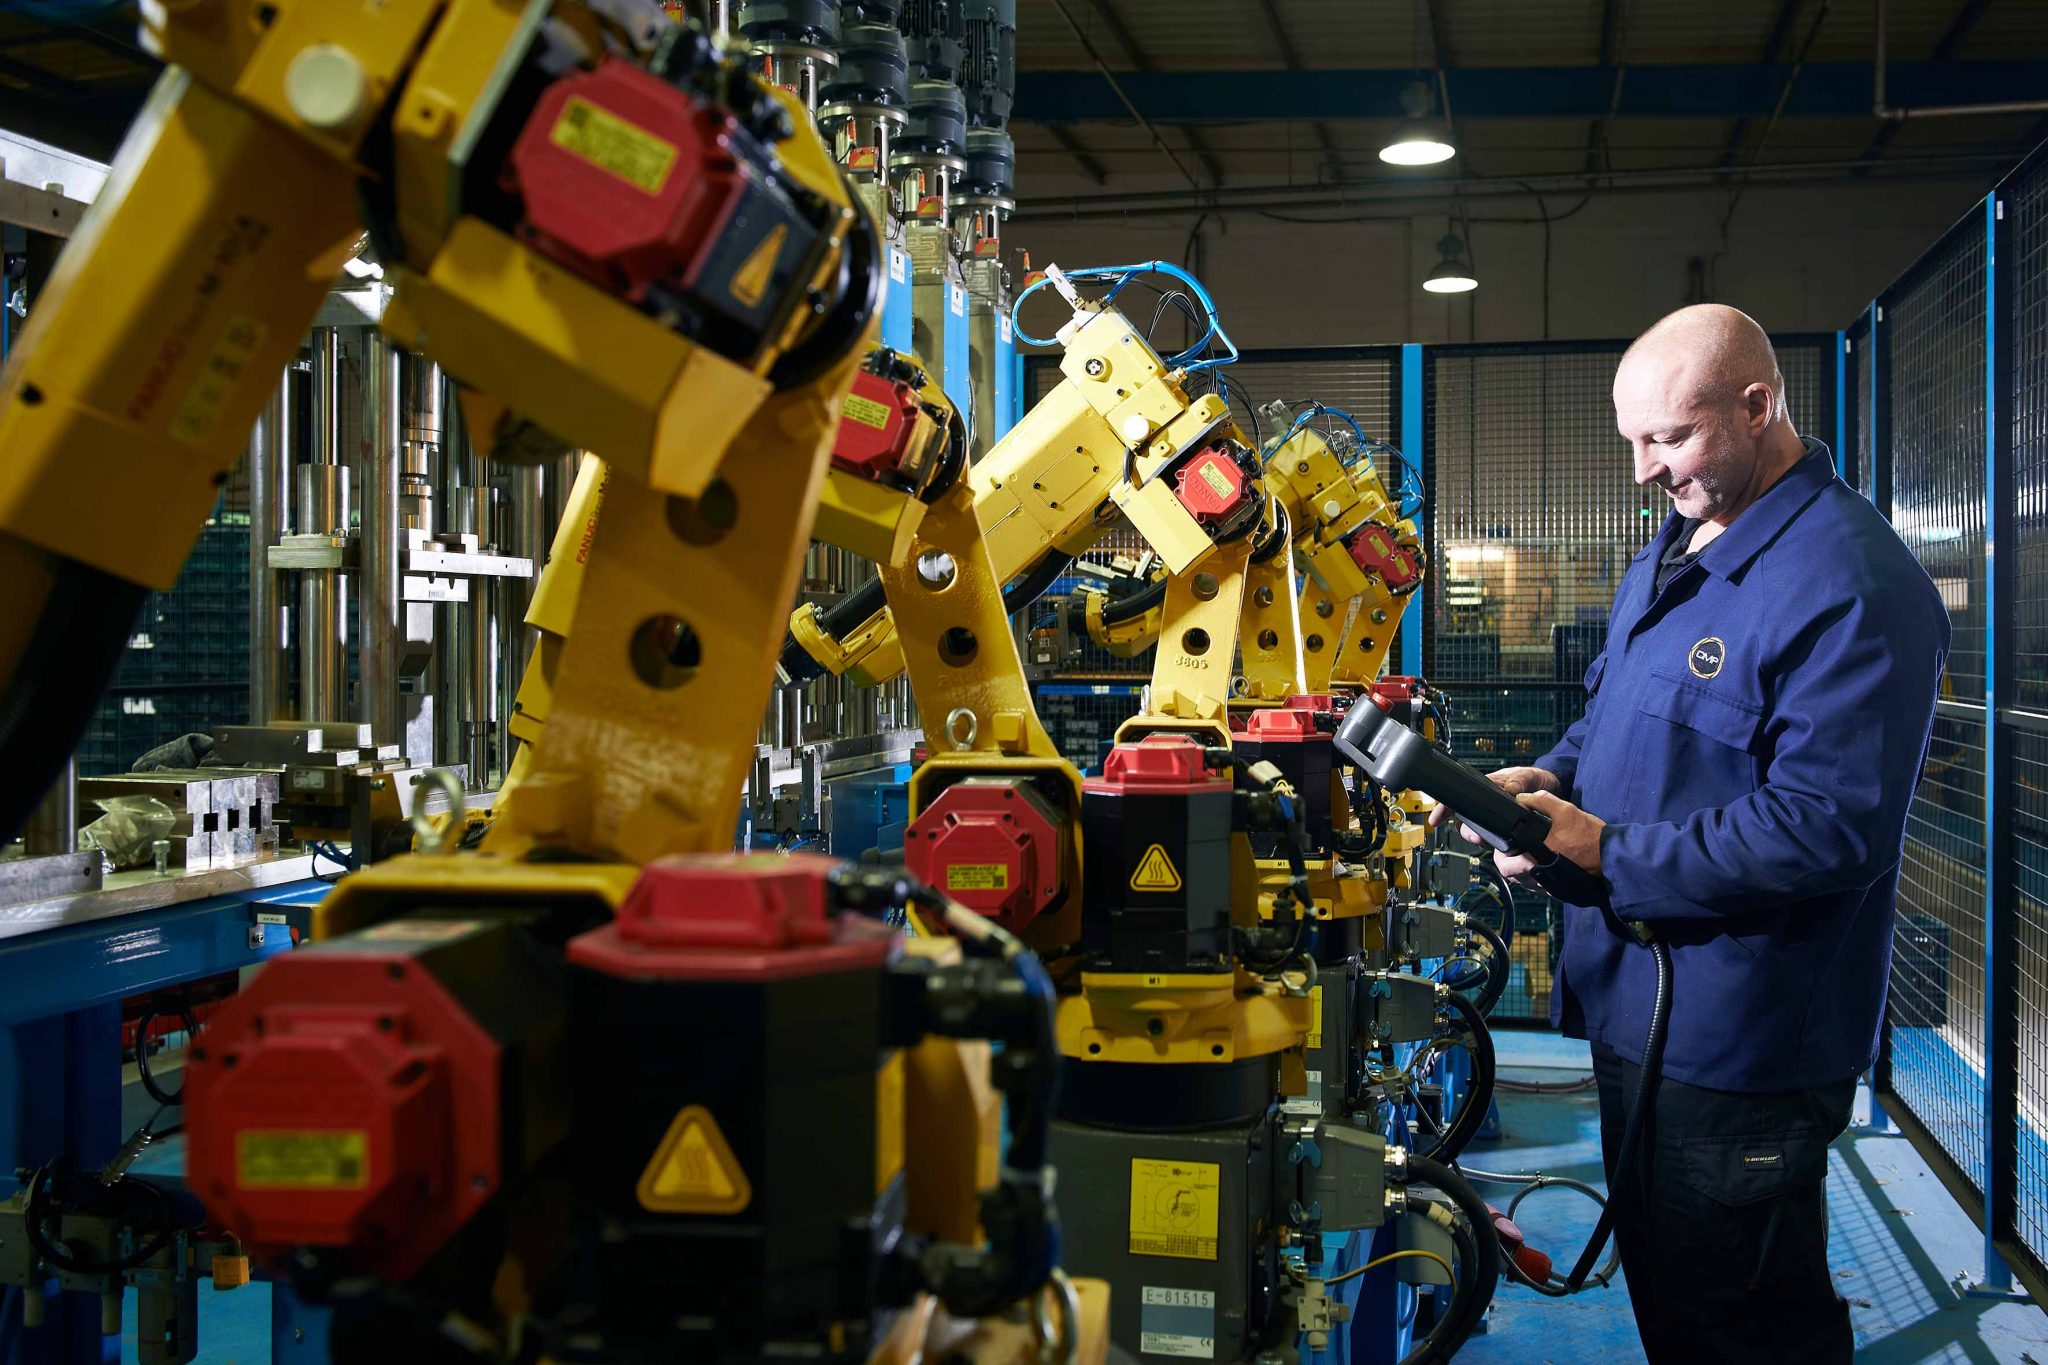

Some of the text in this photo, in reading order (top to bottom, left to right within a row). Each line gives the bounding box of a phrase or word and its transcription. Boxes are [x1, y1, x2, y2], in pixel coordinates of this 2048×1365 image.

[1188, 475, 1221, 512] FANUC
[576, 518, 598, 565] FANUC
[1148, 976, 1161, 984] M1
